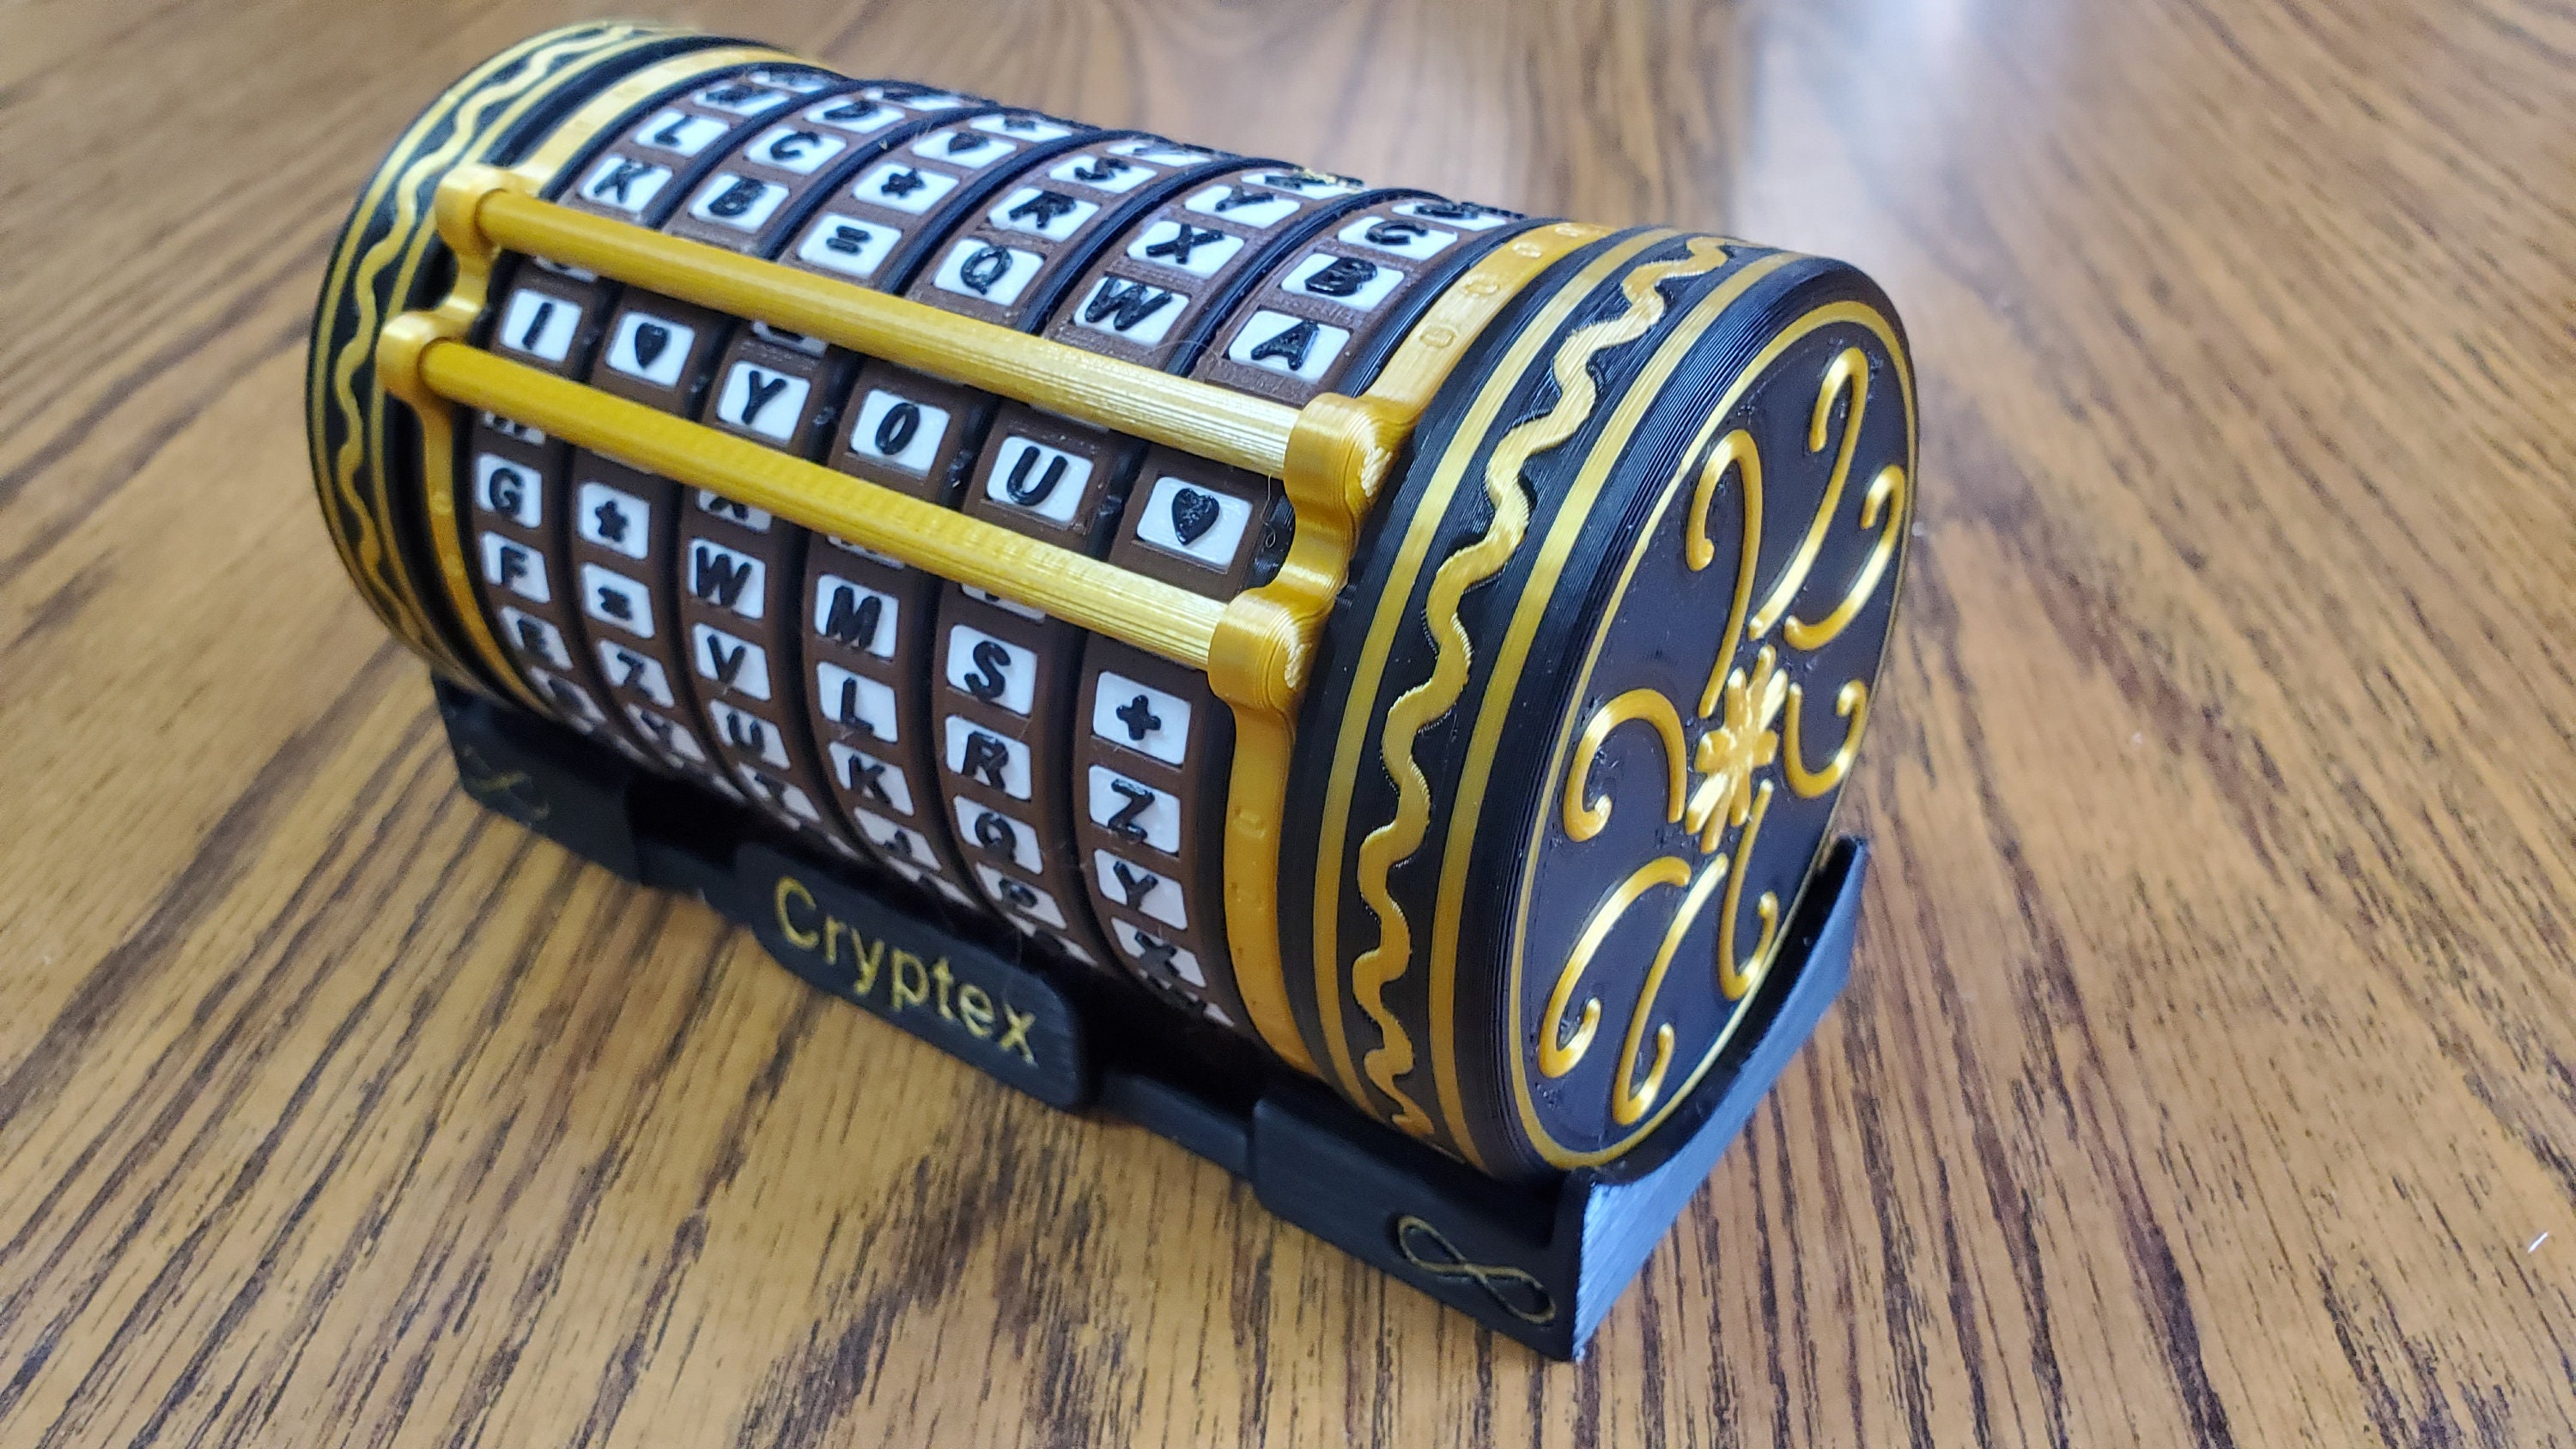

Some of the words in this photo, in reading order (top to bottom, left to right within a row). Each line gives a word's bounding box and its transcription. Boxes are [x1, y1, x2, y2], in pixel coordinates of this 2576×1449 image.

[1250, 318, 1321, 371] A
[489, 467, 524, 517] G
[696, 546, 752, 607] W
[825, 585, 883, 650] M
[963, 640, 1012, 700] S
[775, 876, 1038, 1068] Cryptex
